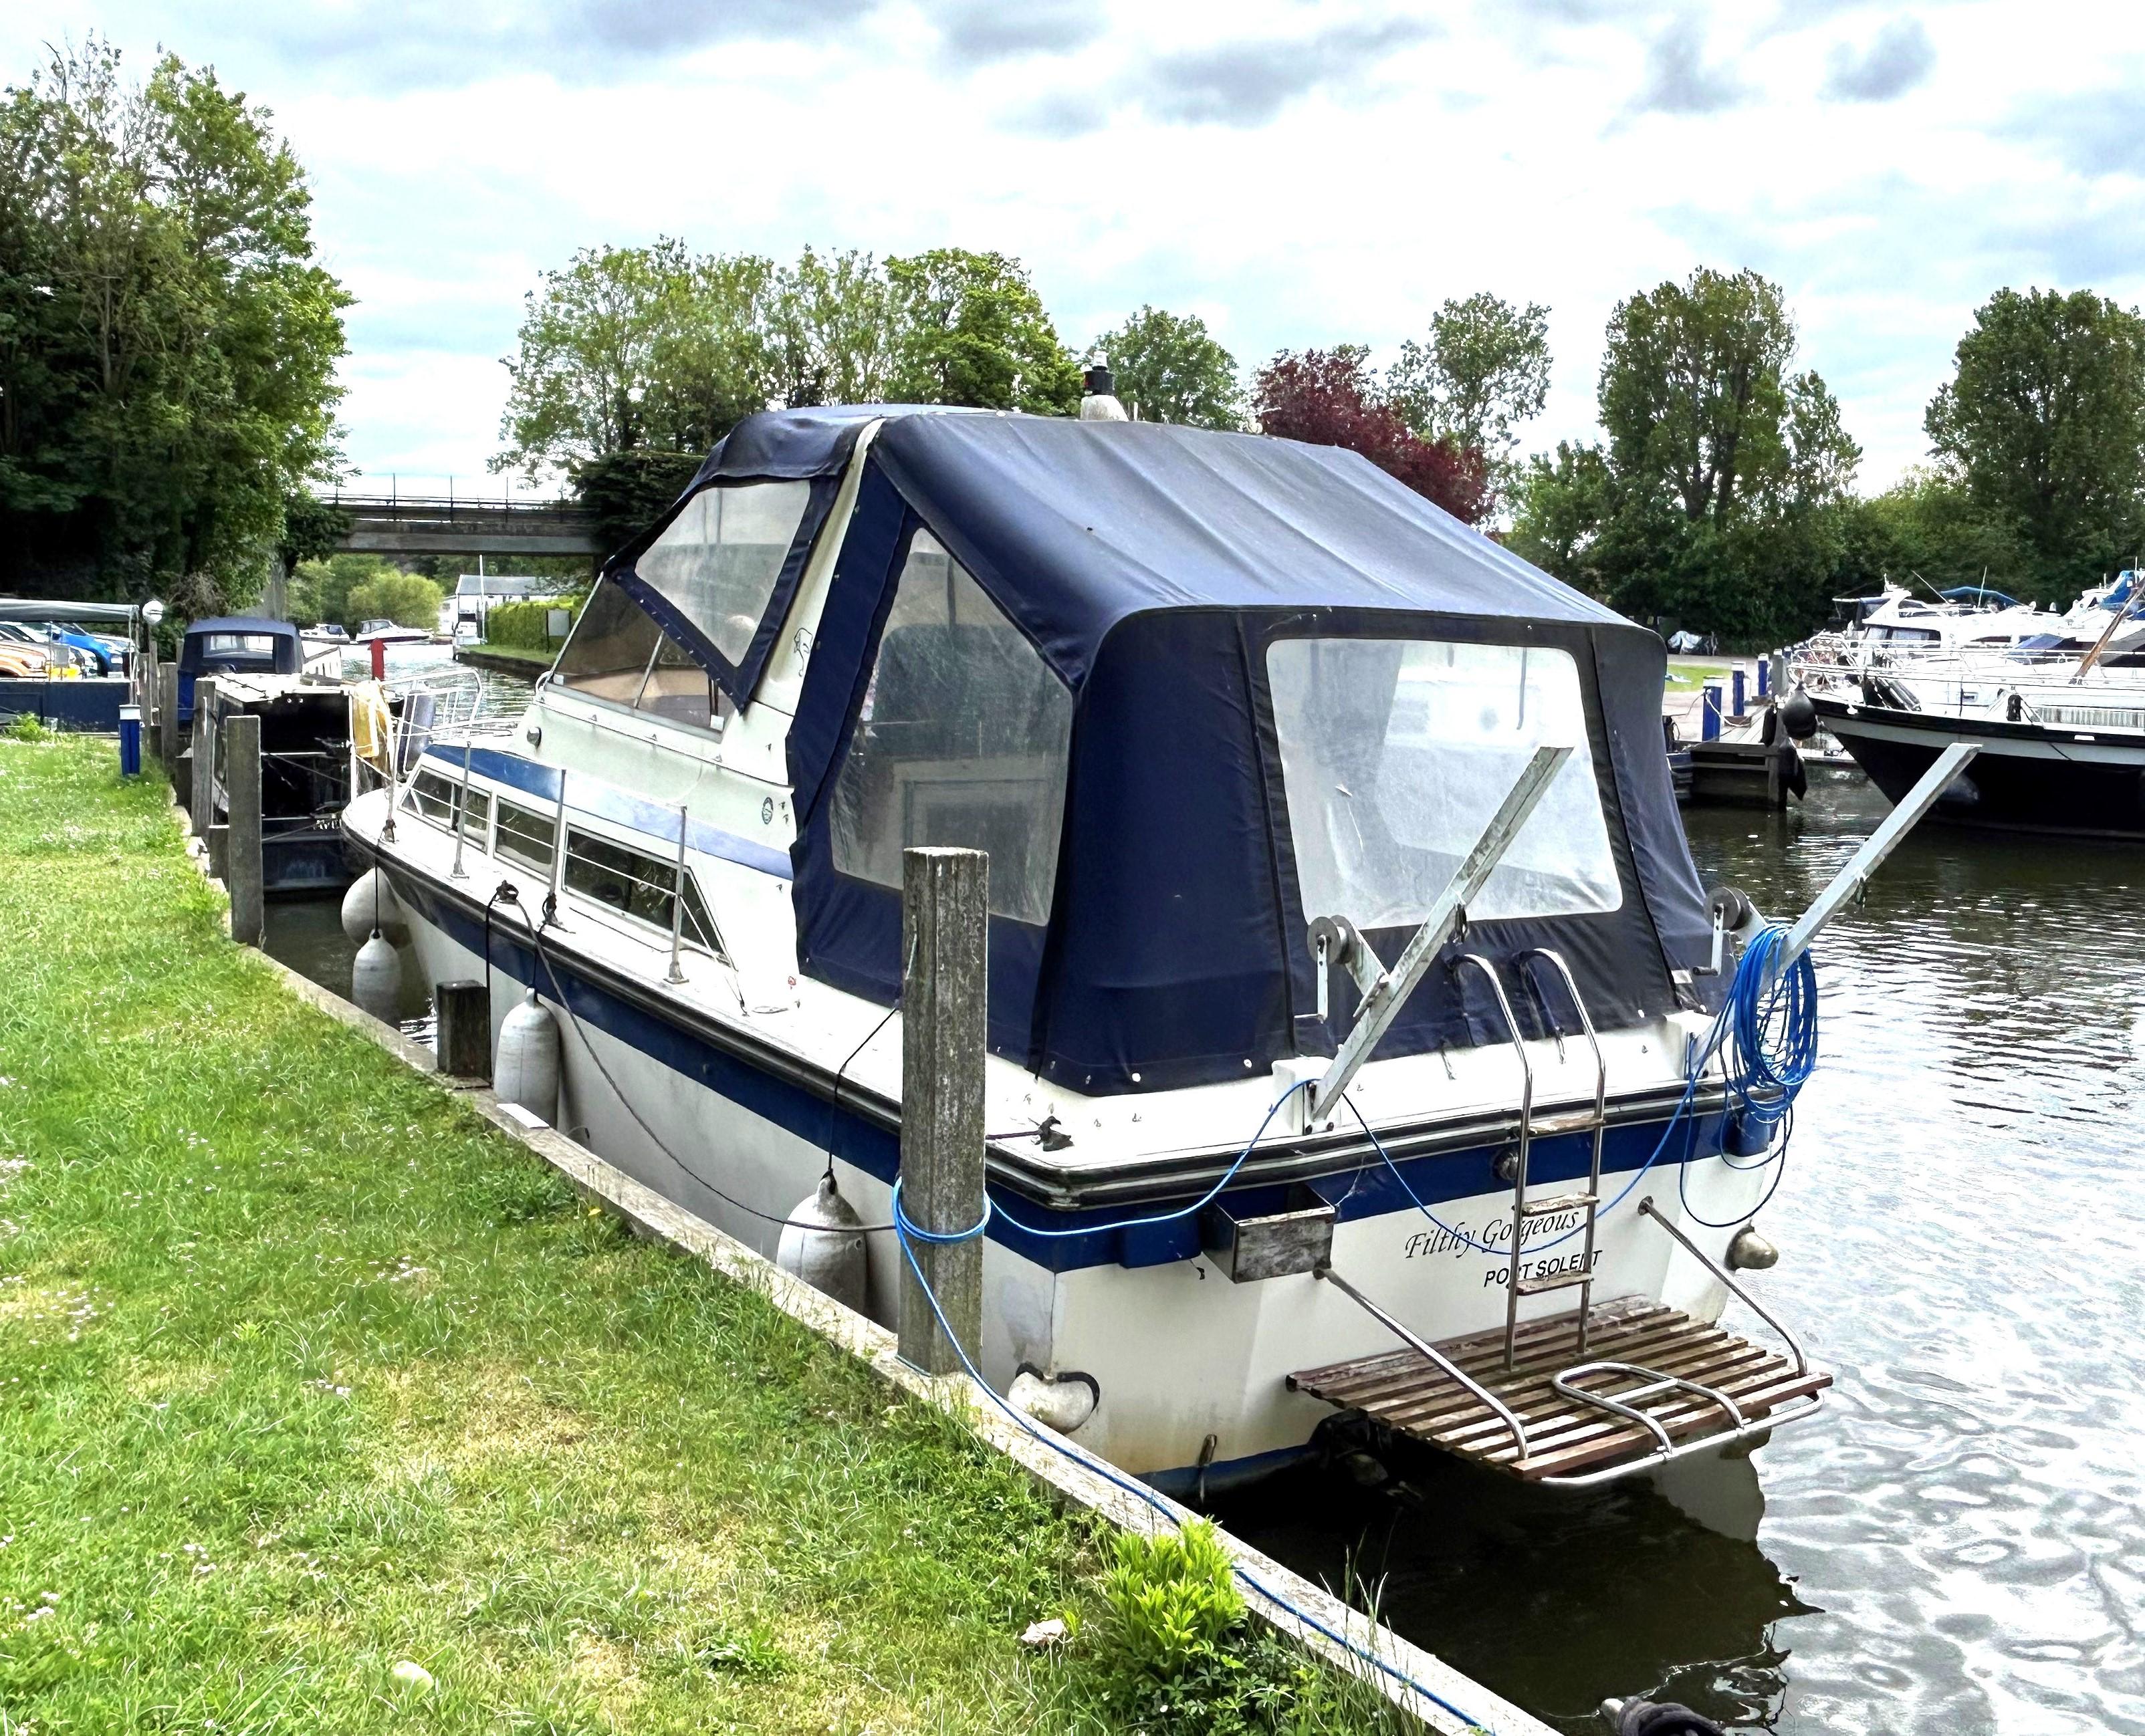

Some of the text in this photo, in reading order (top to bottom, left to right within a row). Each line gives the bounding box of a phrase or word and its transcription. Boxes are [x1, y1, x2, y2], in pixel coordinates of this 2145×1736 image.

[1404, 1211, 1579, 1259] Filthy Gogeous
[1484, 1263, 1533, 1288] POT
